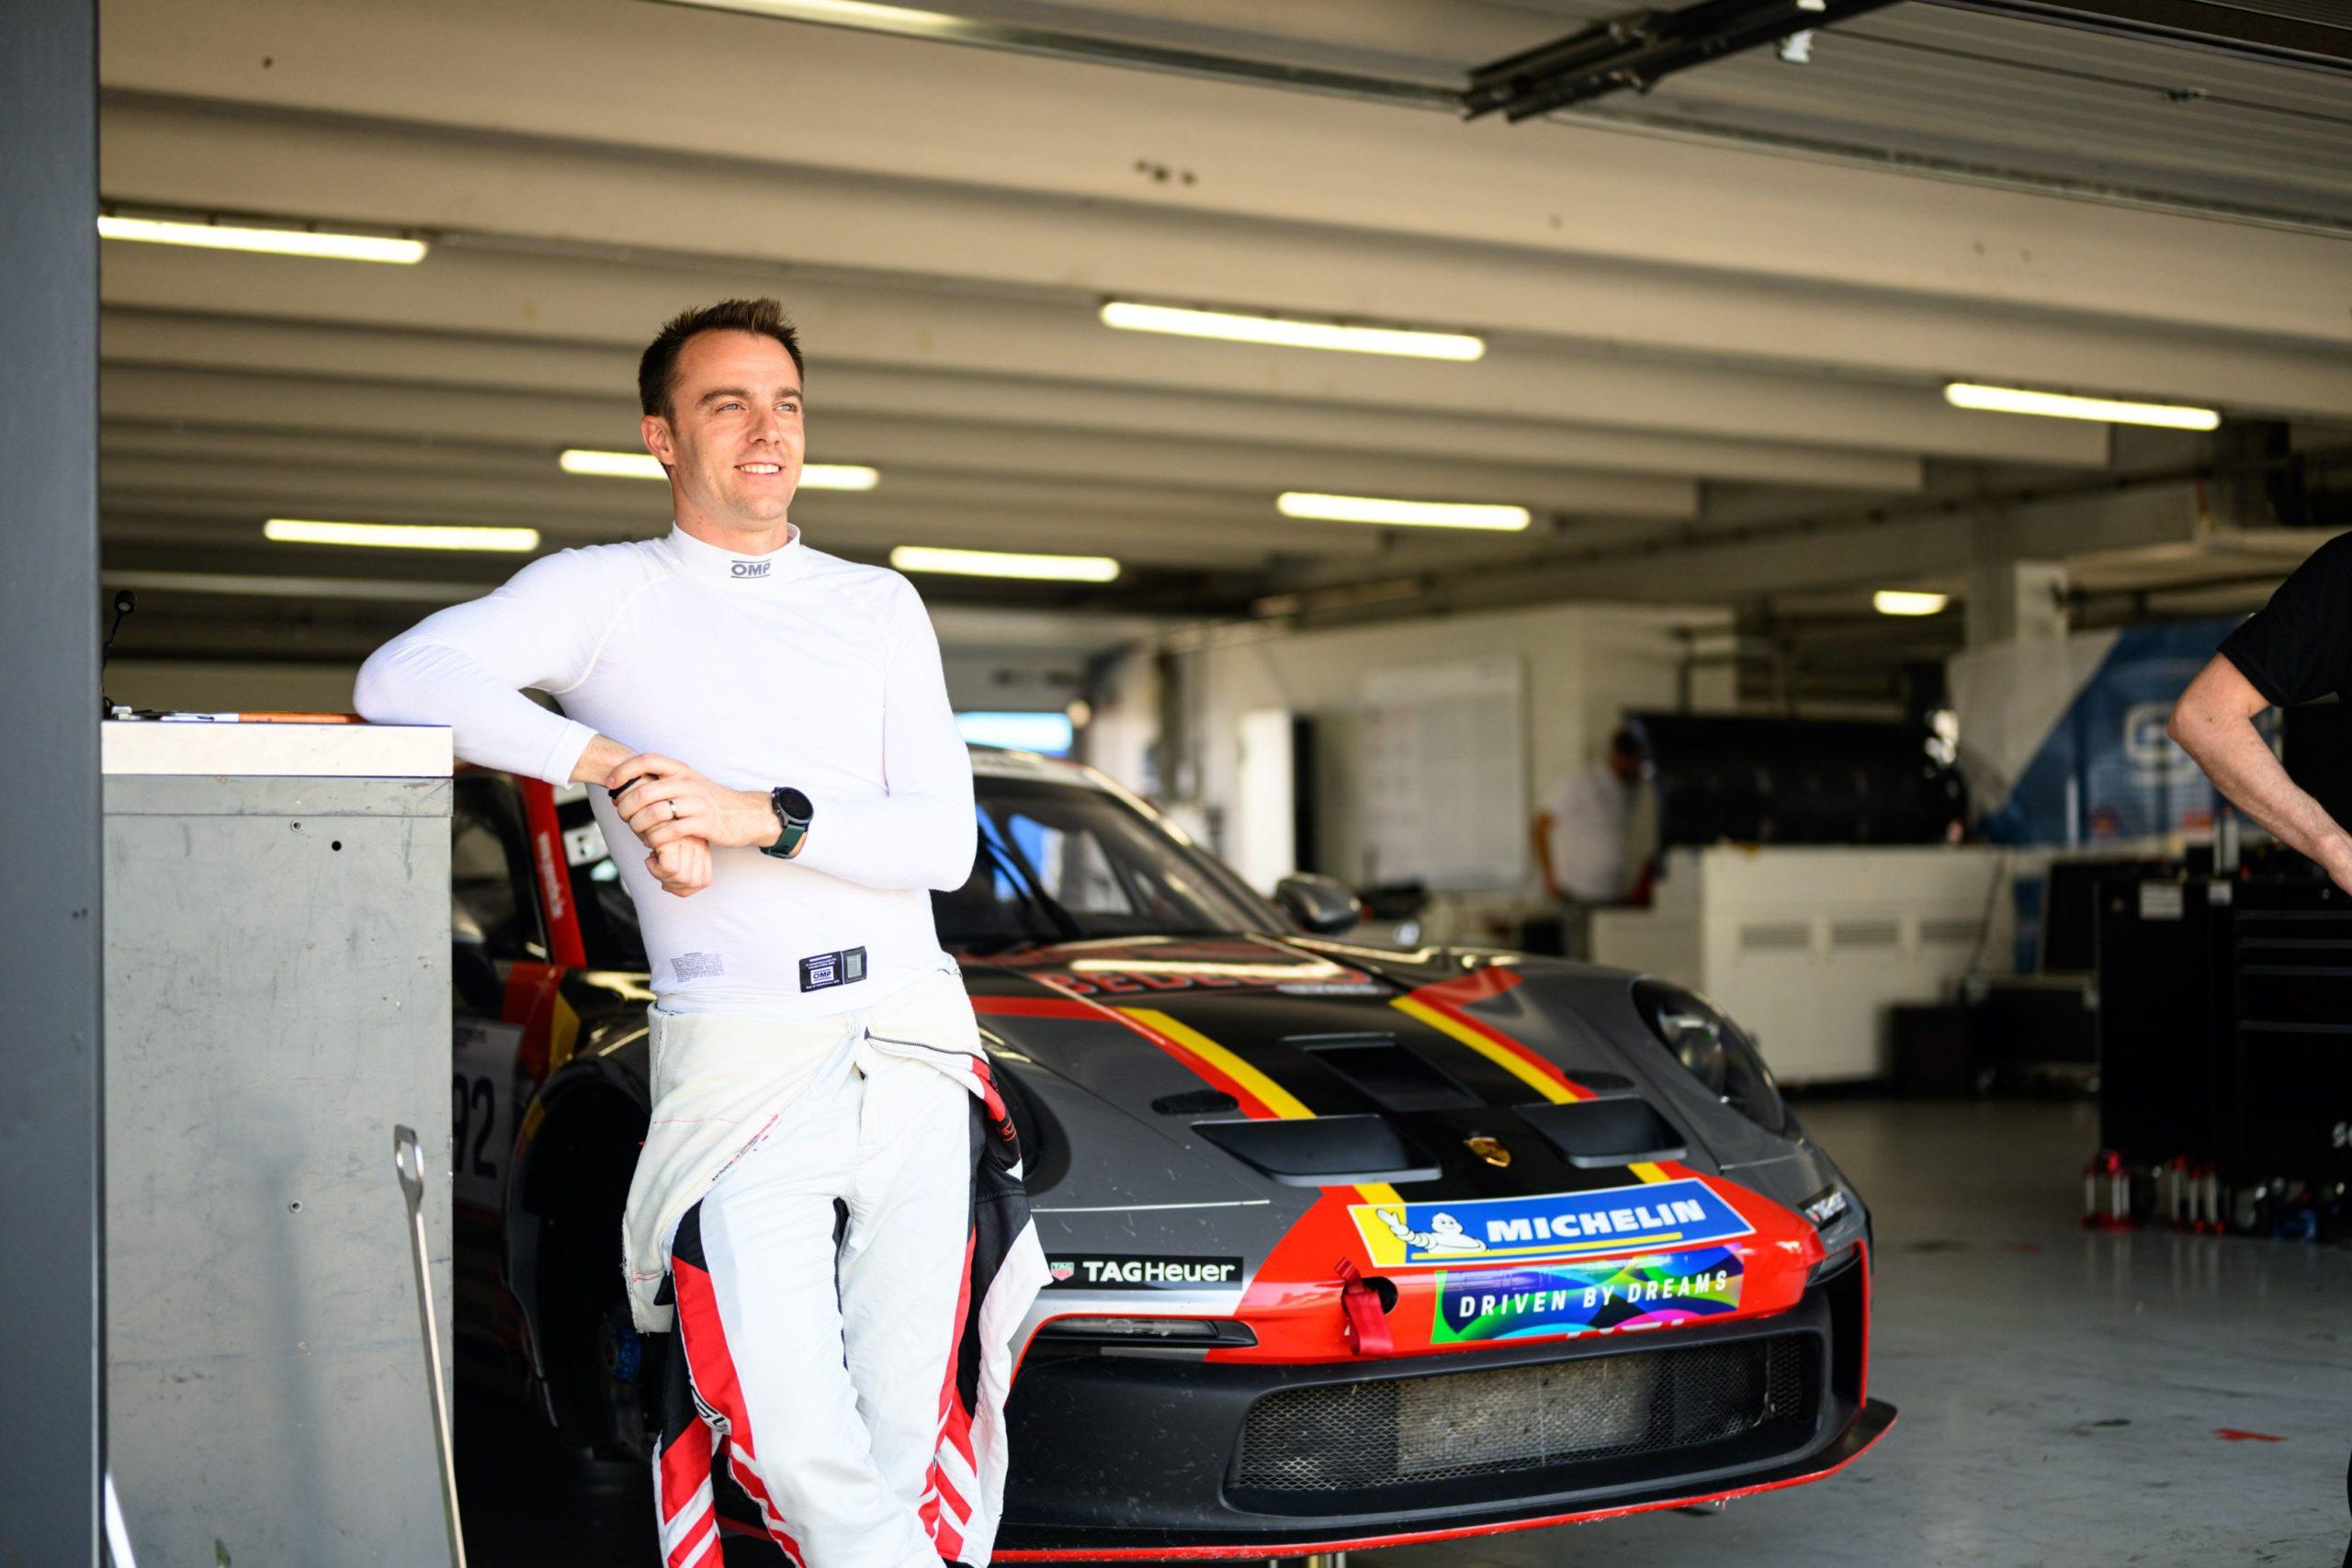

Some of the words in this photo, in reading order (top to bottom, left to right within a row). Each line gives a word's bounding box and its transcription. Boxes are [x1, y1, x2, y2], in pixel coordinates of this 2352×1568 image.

[730, 561, 771, 576] OMP
[813, 970, 831, 979] OMP
[1486, 1199, 1706, 1243] MICHELIN
[1459, 1290, 1566, 1318] DRIVEN
[1582, 1285, 1614, 1309] BY
[1627, 1269, 1727, 1303] DREAMS
